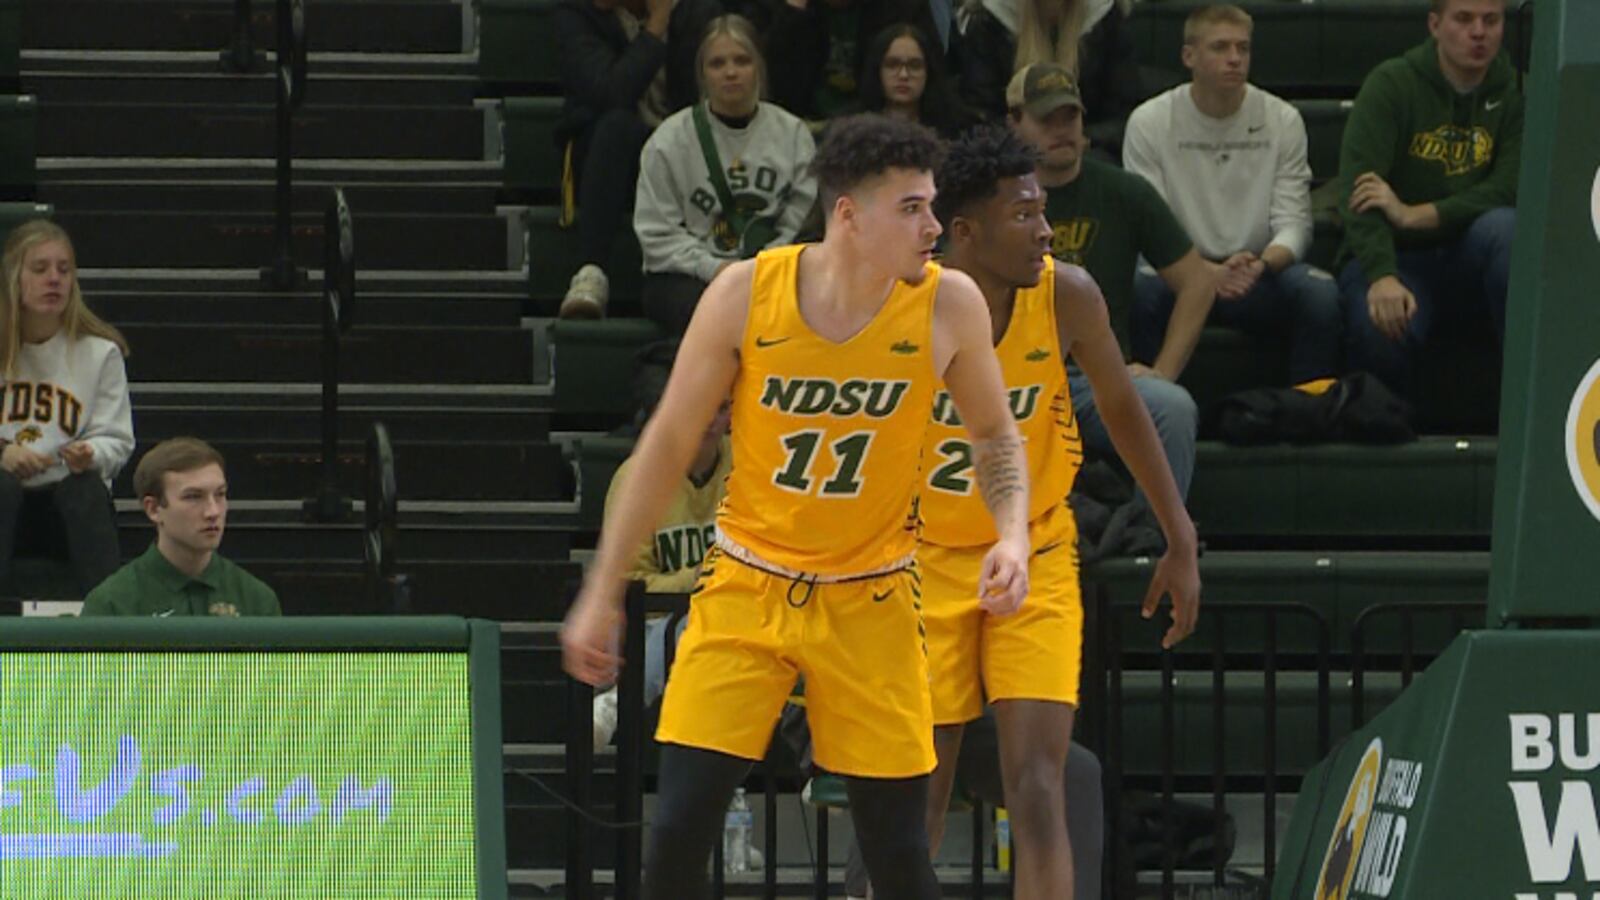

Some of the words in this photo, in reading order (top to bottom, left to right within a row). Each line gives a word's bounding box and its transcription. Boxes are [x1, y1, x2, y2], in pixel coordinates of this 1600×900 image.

[760, 375, 911, 420] NDSU
[771, 428, 877, 498] 11
[928, 437, 977, 496] 2
